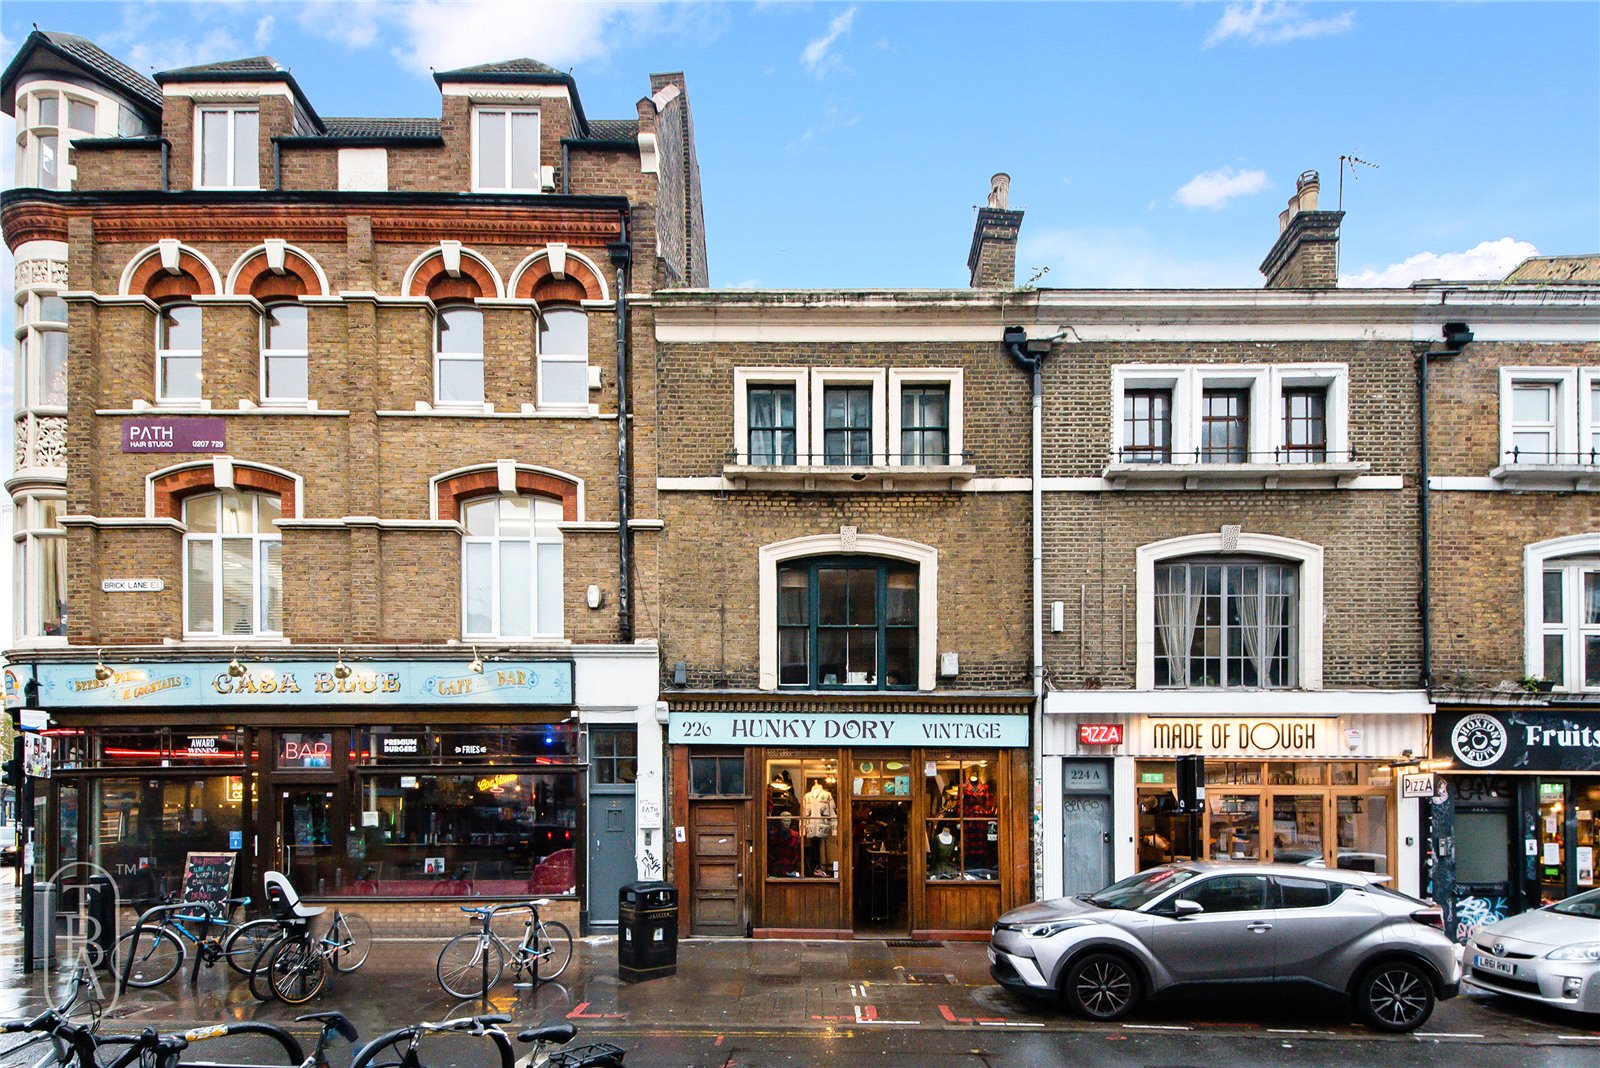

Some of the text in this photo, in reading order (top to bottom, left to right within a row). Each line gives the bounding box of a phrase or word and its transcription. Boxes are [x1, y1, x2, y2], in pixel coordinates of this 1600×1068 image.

[130, 426, 173, 440] PATH
[192, 440, 209, 448] 0207
[211, 440, 224, 448] 729
[103, 581, 126, 589] BRICK
[127, 581, 148, 589] LANE
[133, 676, 182, 699] COCKTAILS
[211, 671, 401, 694] CASA BLUE
[437, 678, 473, 696] CAFE
[496, 670, 527, 687] BAR
[682, 719, 1001, 739] 226 HUNKY DORY VINTAGE
[1153, 722, 1316, 750] MADE OF DOUGH
[1460, 719, 1501, 739] HOXTON
[1525, 724, 1600, 747] Fruits
[190, 738, 216, 748] AWARD
[383, 738, 418, 746] PREMIUM
[383, 745, 418, 753] BURGERS
[461, 745, 481, 754] FRIES
[285, 742, 328, 760] BAR
[1460, 745, 1496, 761] FRUIT
[1070, 770, 1100, 780] 224 A
[1405, 778, 1433, 792] PIZZA
